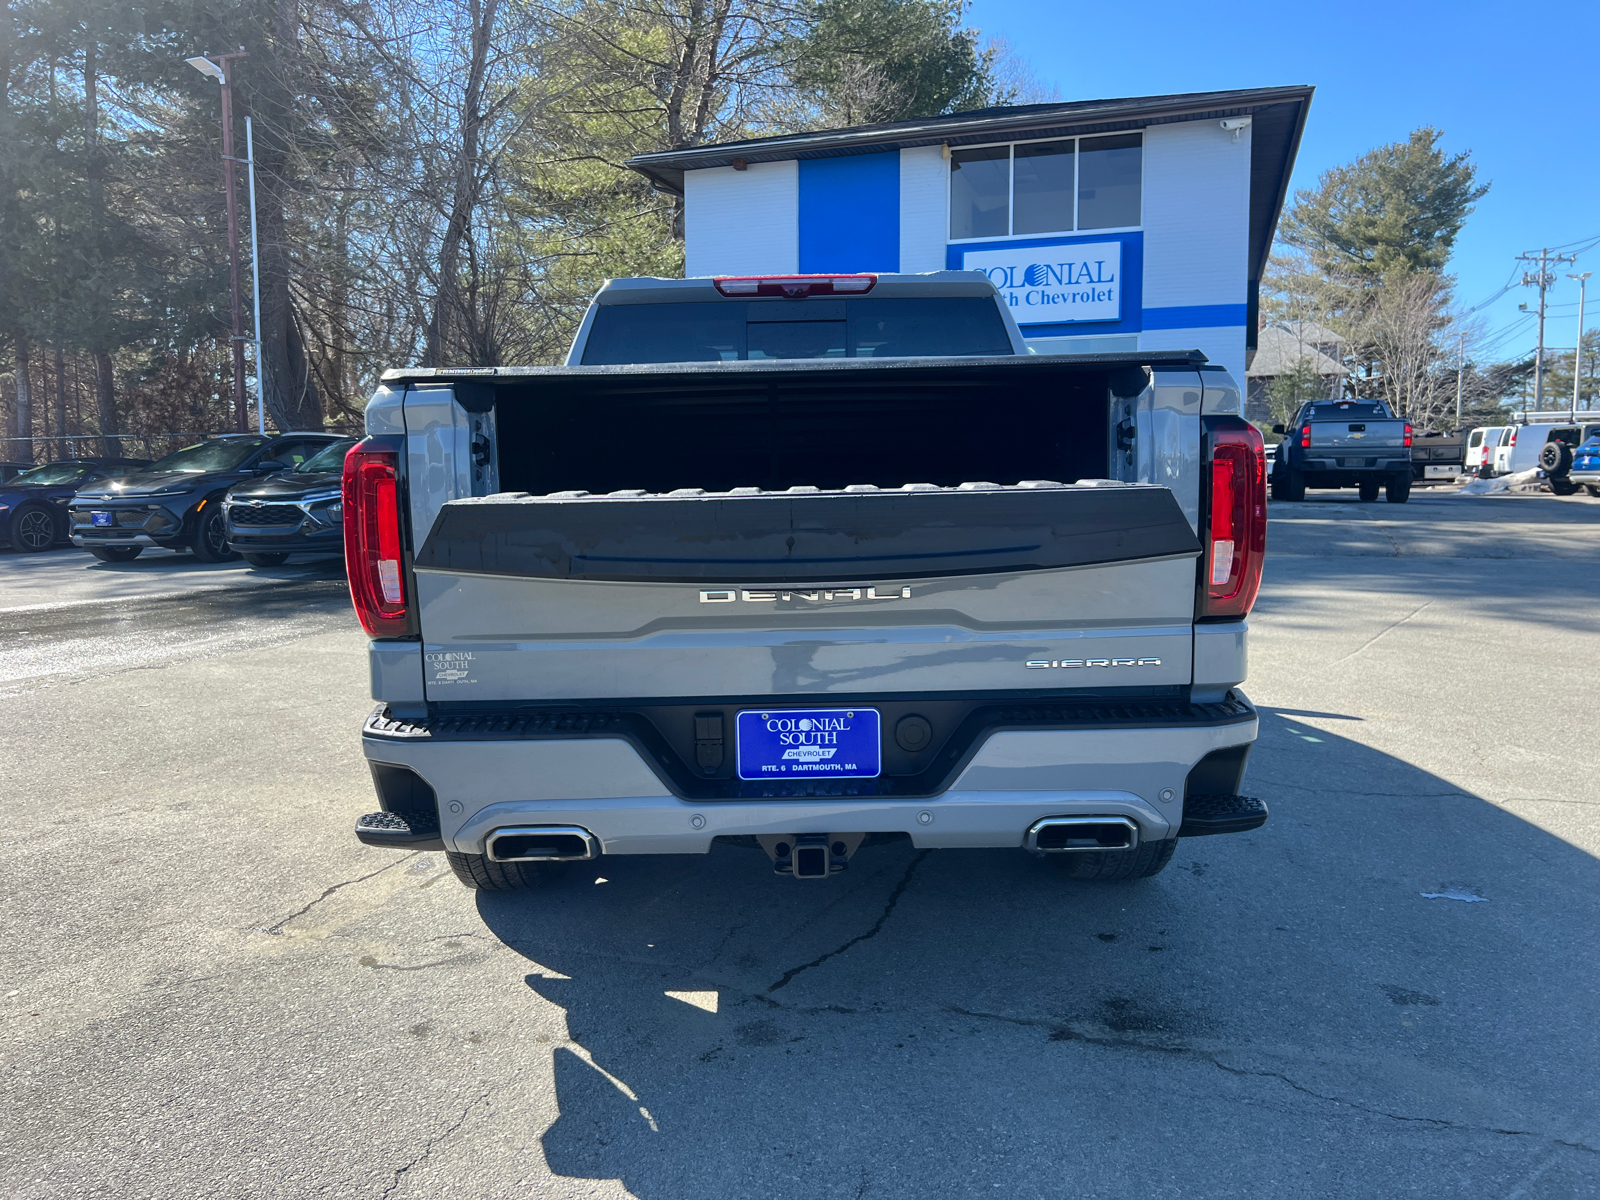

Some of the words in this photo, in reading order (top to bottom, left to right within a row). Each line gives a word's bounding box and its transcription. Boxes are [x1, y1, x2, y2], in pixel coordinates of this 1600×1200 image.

[973, 261, 1115, 290] OLONIAL
[1025, 287, 1114, 306] Chevrolet
[699, 586, 911, 603] DENALI
[425, 651, 476, 662] COLONIAL
[1025, 656, 1162, 669] SIERRA
[433, 660, 469, 670] SOUTH
[767, 717, 851, 732] COLONIAL
[780, 731, 838, 745] SOUTH
